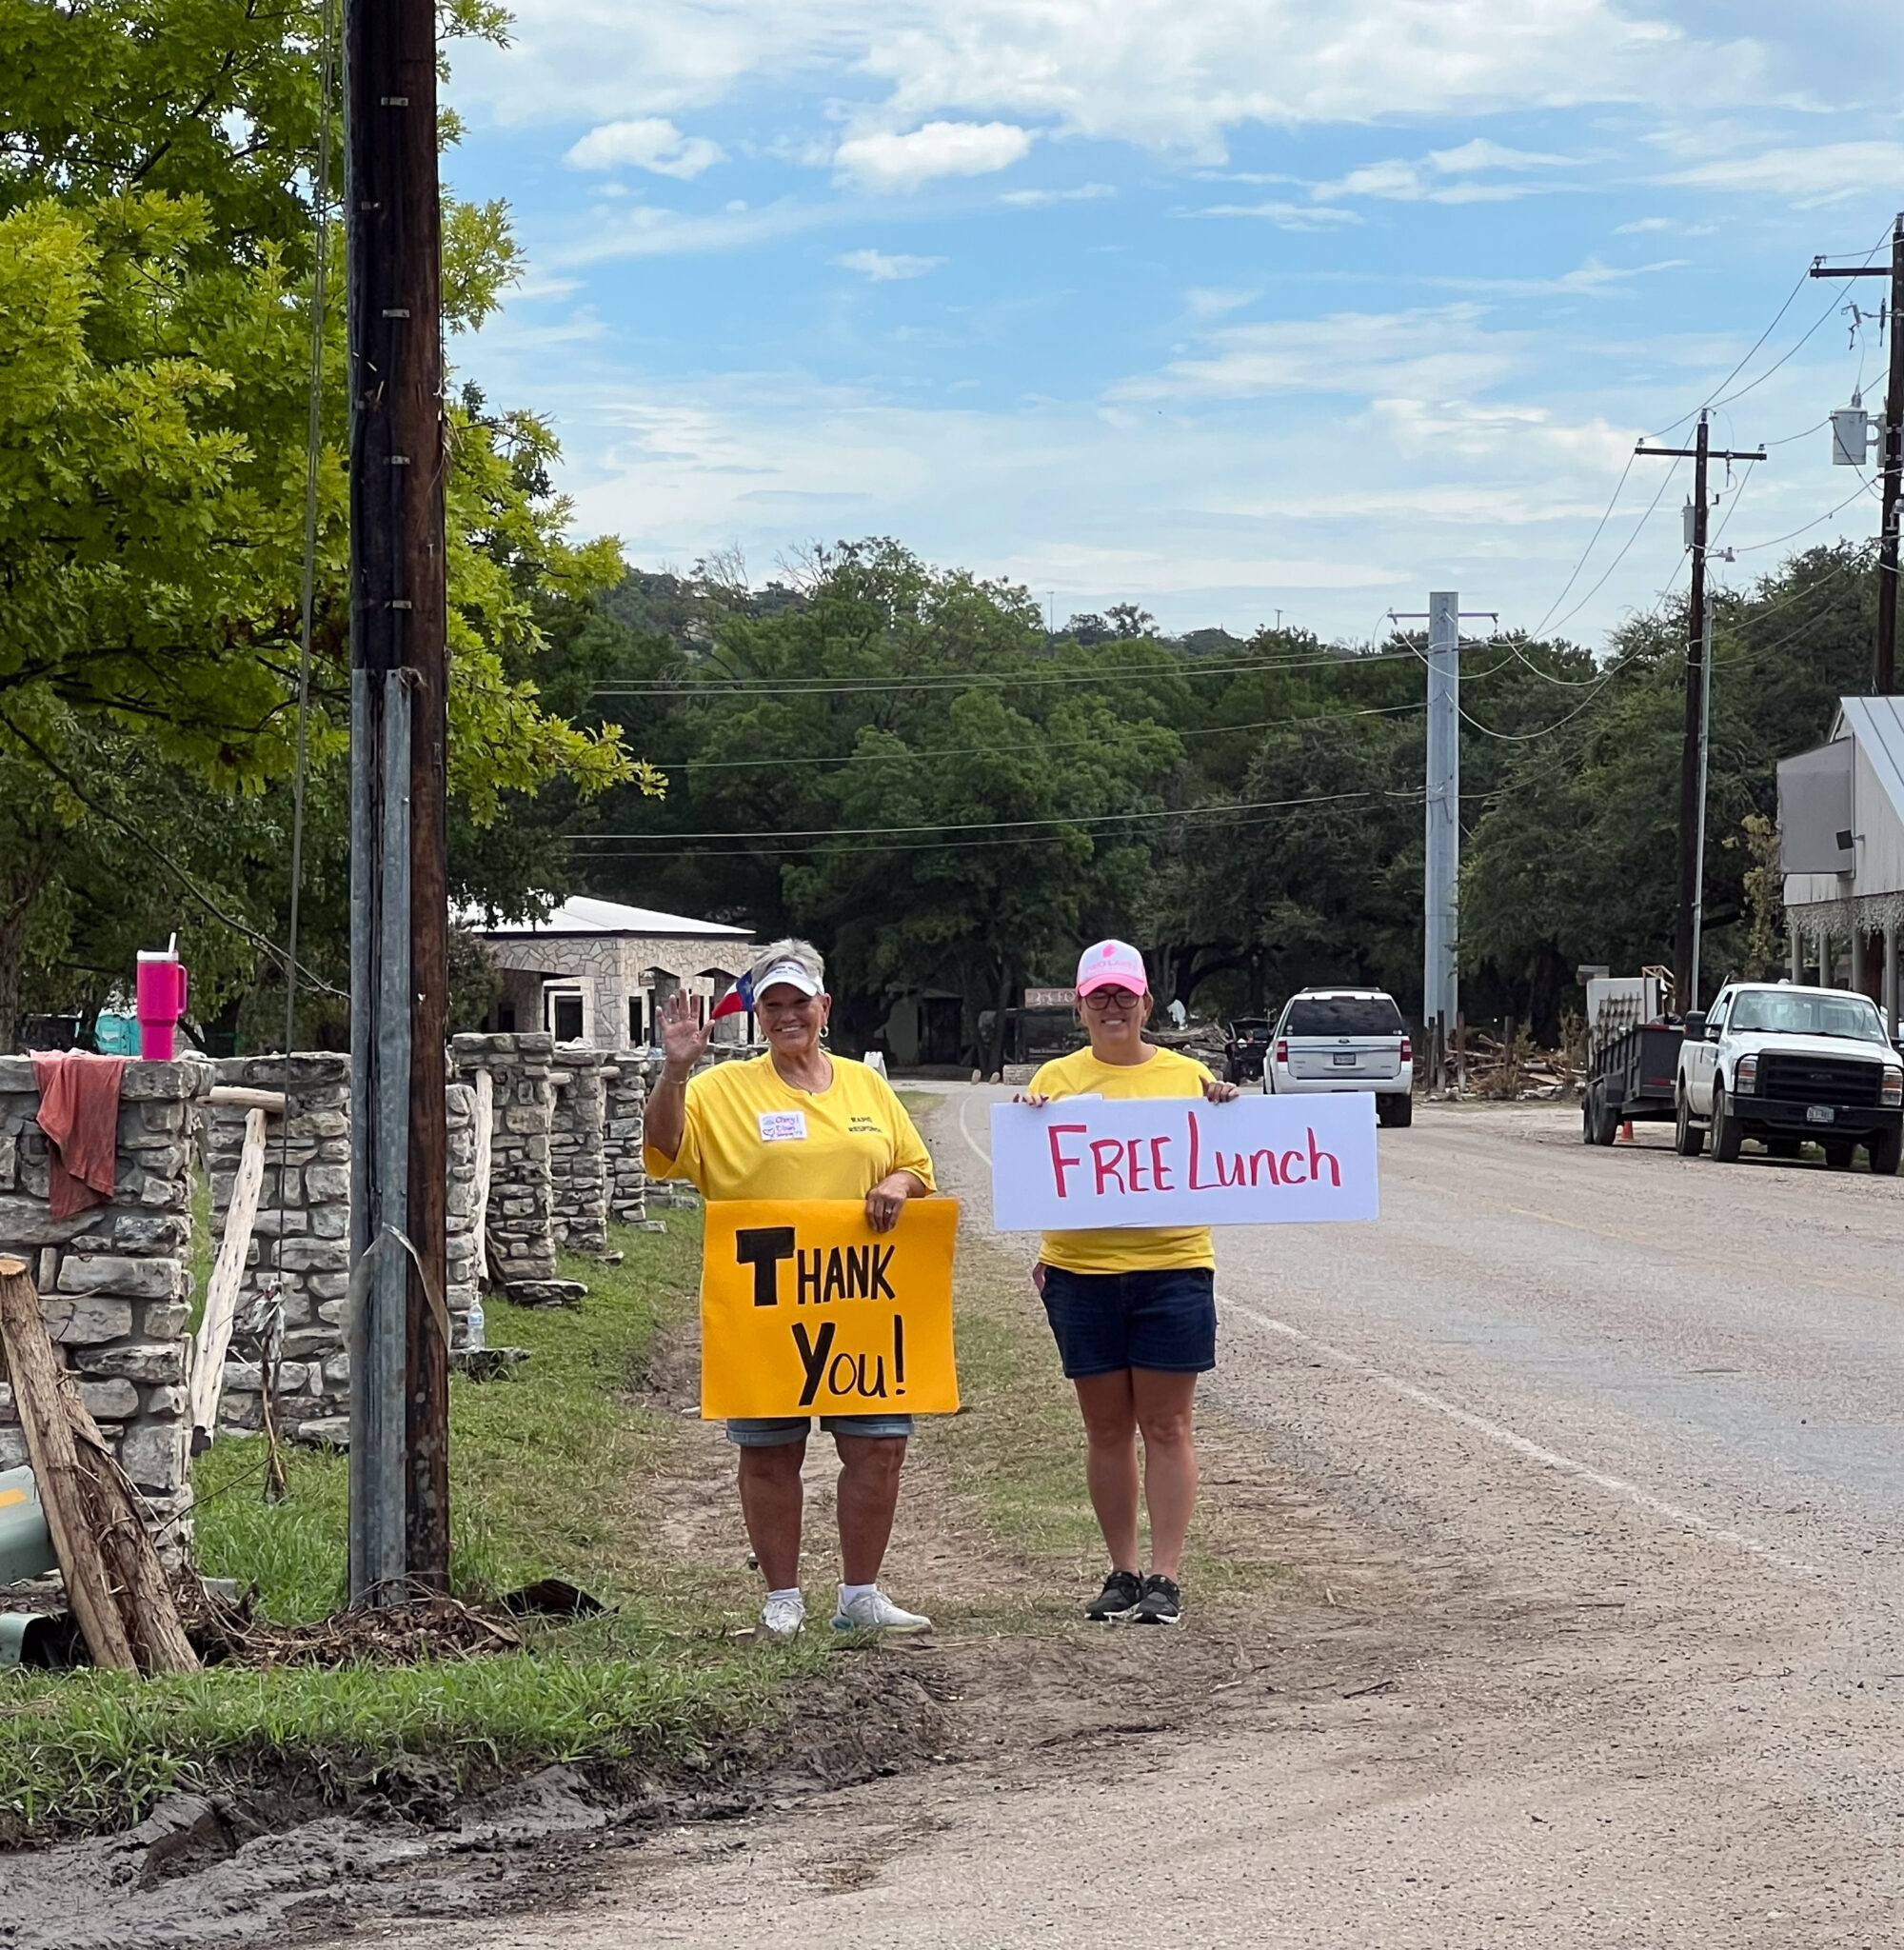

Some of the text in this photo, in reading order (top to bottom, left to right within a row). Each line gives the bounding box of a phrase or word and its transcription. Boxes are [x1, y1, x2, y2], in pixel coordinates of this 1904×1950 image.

[1047, 1110, 1341, 1198] FREE Lunch
[736, 1226, 896, 1307] THANK
